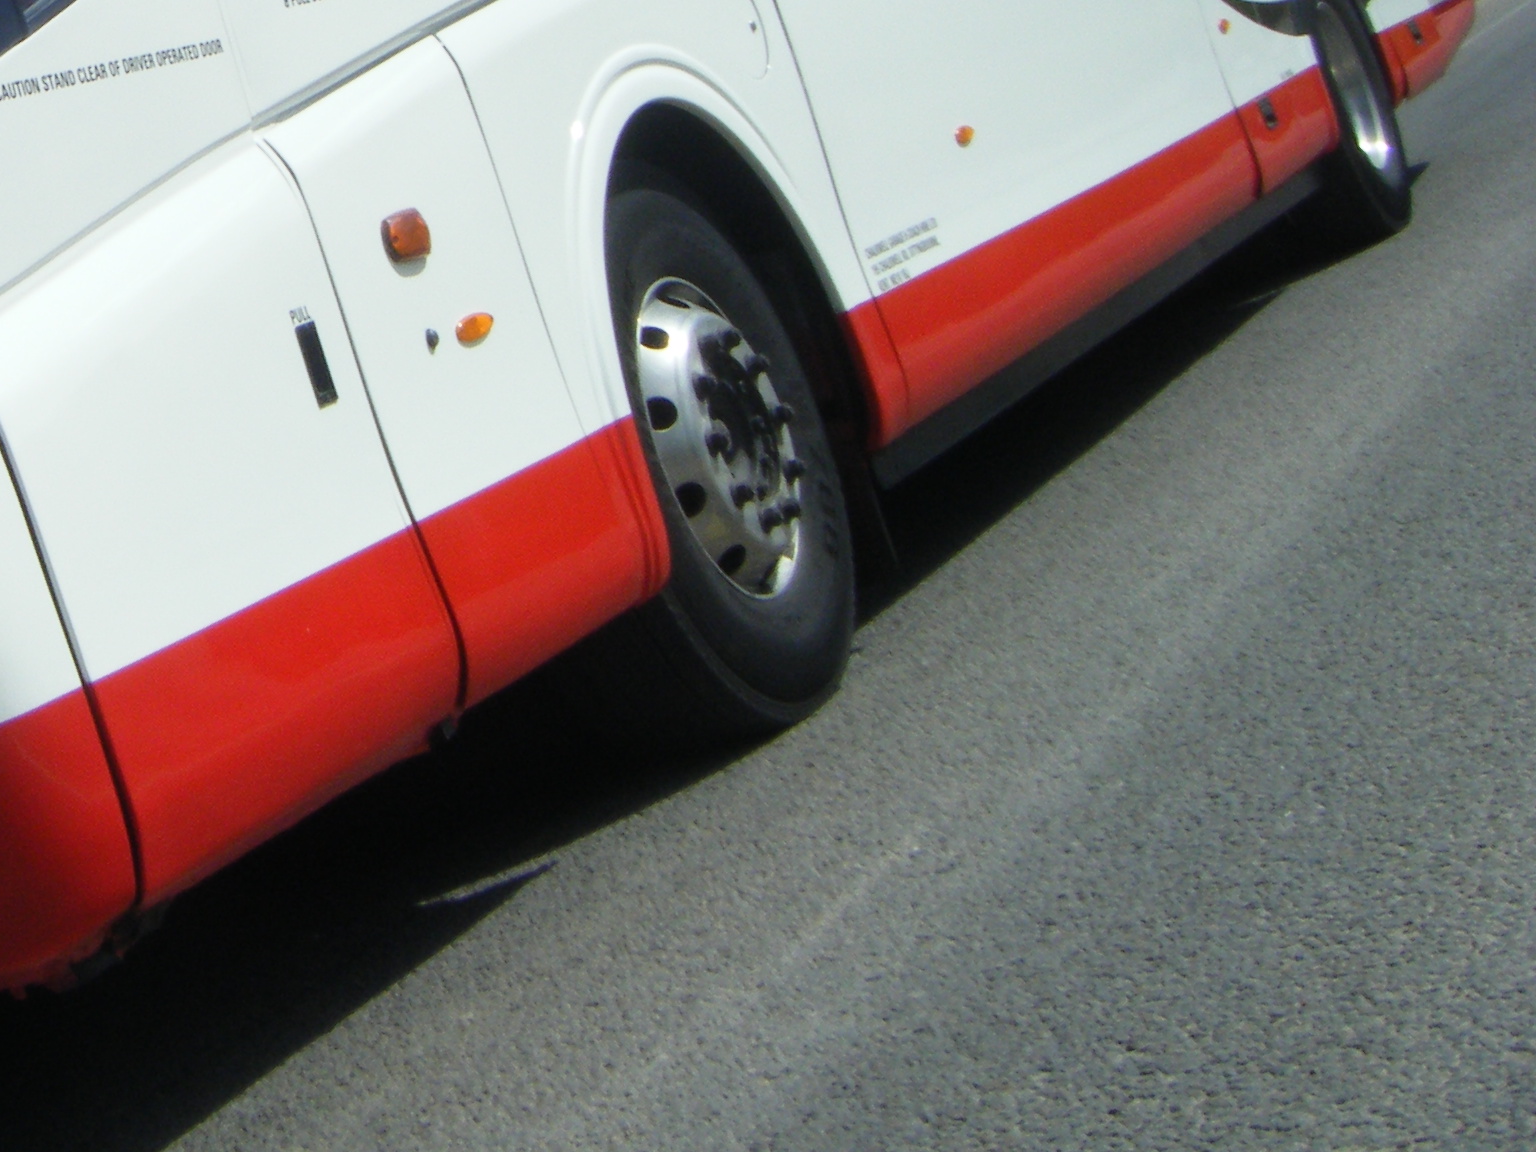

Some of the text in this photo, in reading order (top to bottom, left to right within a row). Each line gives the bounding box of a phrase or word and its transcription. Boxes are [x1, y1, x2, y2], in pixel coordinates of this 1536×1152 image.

[41, 70, 76, 92] STAND
[76, 62, 108, 84] CLEAR
[108, 59, 121, 77] OF
[122, 53, 156, 74] DRIVER
[155, 44, 200, 67] OPERATED
[199, 38, 224, 58] DOOR
[289, 305, 311, 325] PULL
